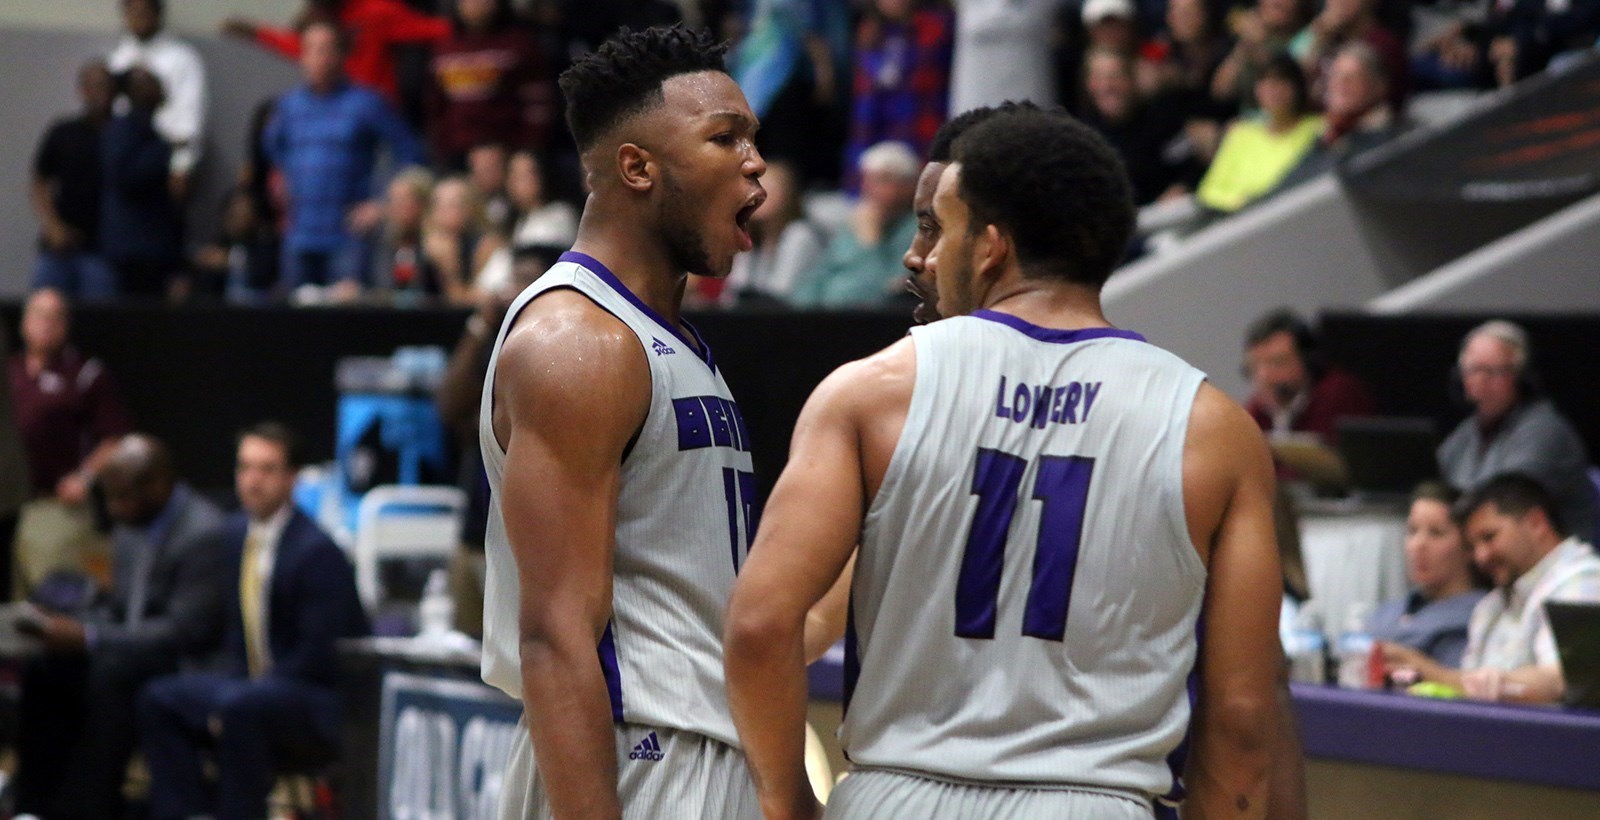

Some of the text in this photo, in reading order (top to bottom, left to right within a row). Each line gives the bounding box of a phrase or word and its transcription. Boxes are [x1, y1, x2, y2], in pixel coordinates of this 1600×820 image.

[995, 375, 1102, 430] LOWERY
[954, 446, 1096, 642] 11
[629, 748, 665, 761] adidas
